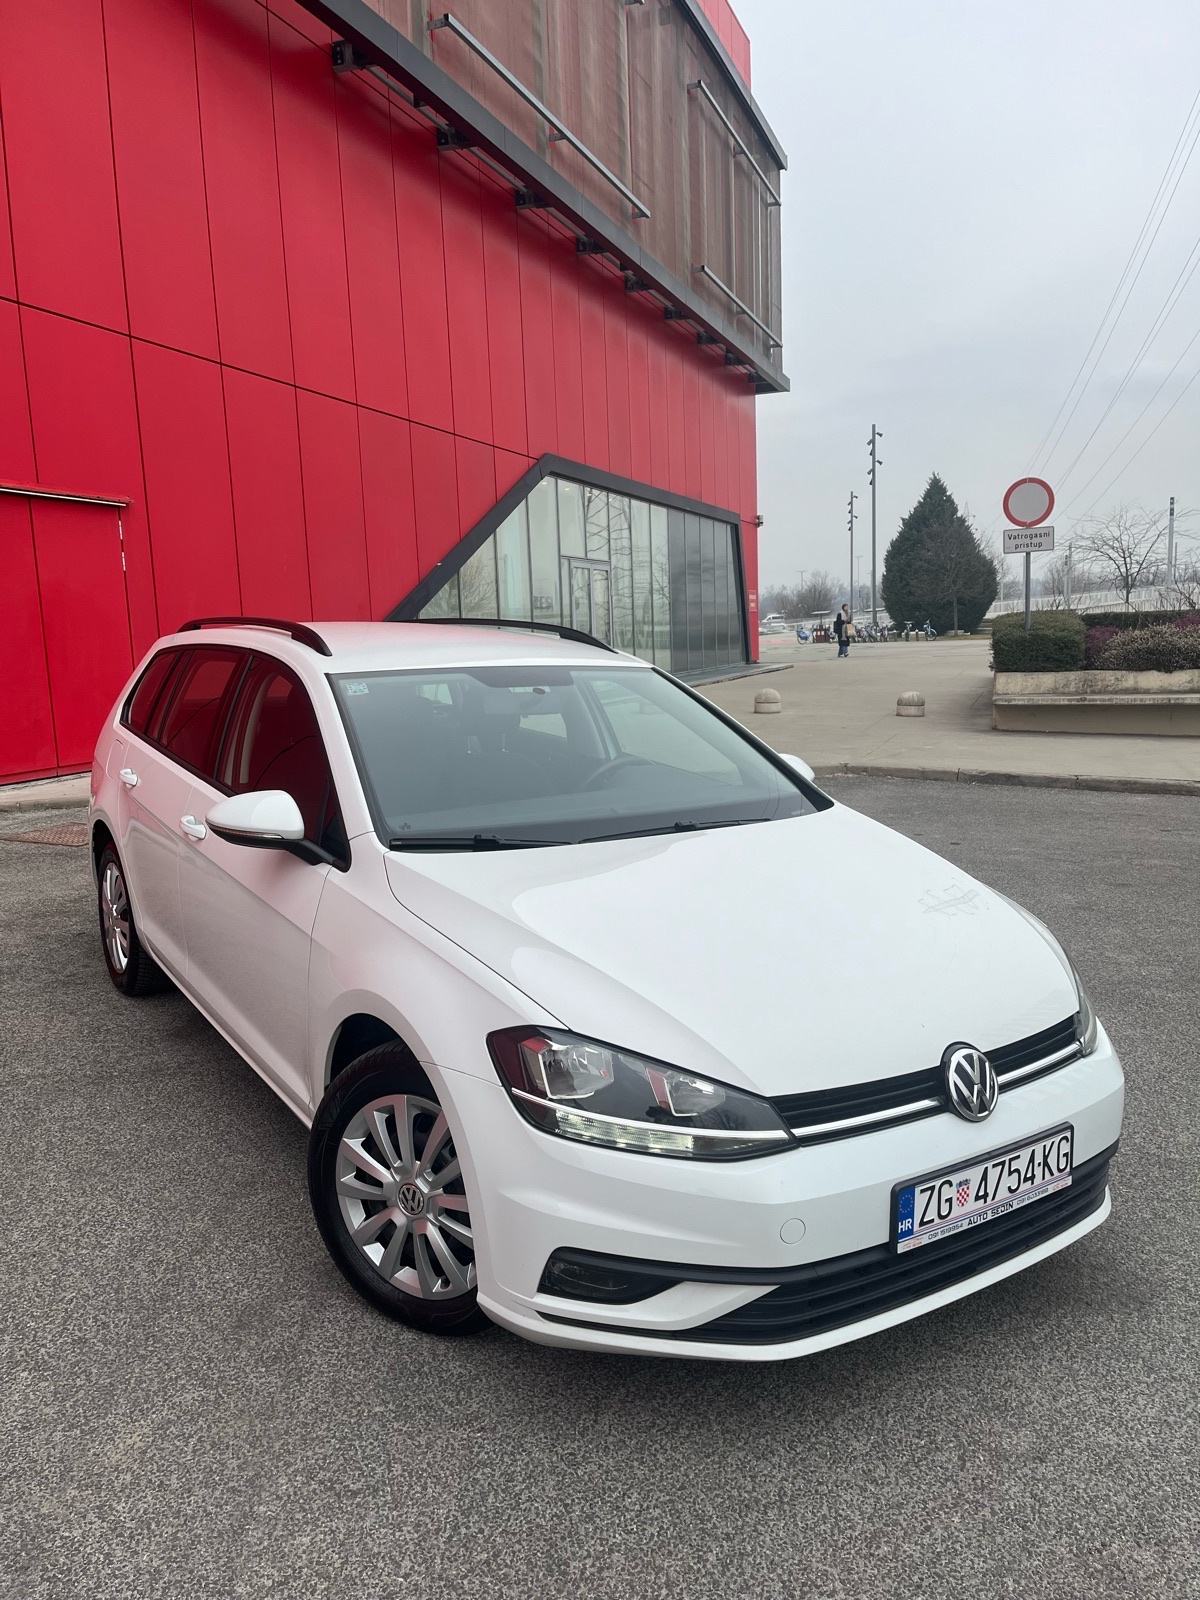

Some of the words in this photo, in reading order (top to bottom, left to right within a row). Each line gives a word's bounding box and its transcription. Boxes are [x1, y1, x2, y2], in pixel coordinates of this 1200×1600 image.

[1007, 531, 1050, 541] Vatrogasni
[1014, 541, 1043, 550] pristup
[918, 1179, 953, 1228] ZG
[967, 1211, 988, 1226] AUTO
[991, 1201, 1014, 1217] SEDIN
[898, 1218, 913, 1233] HR
